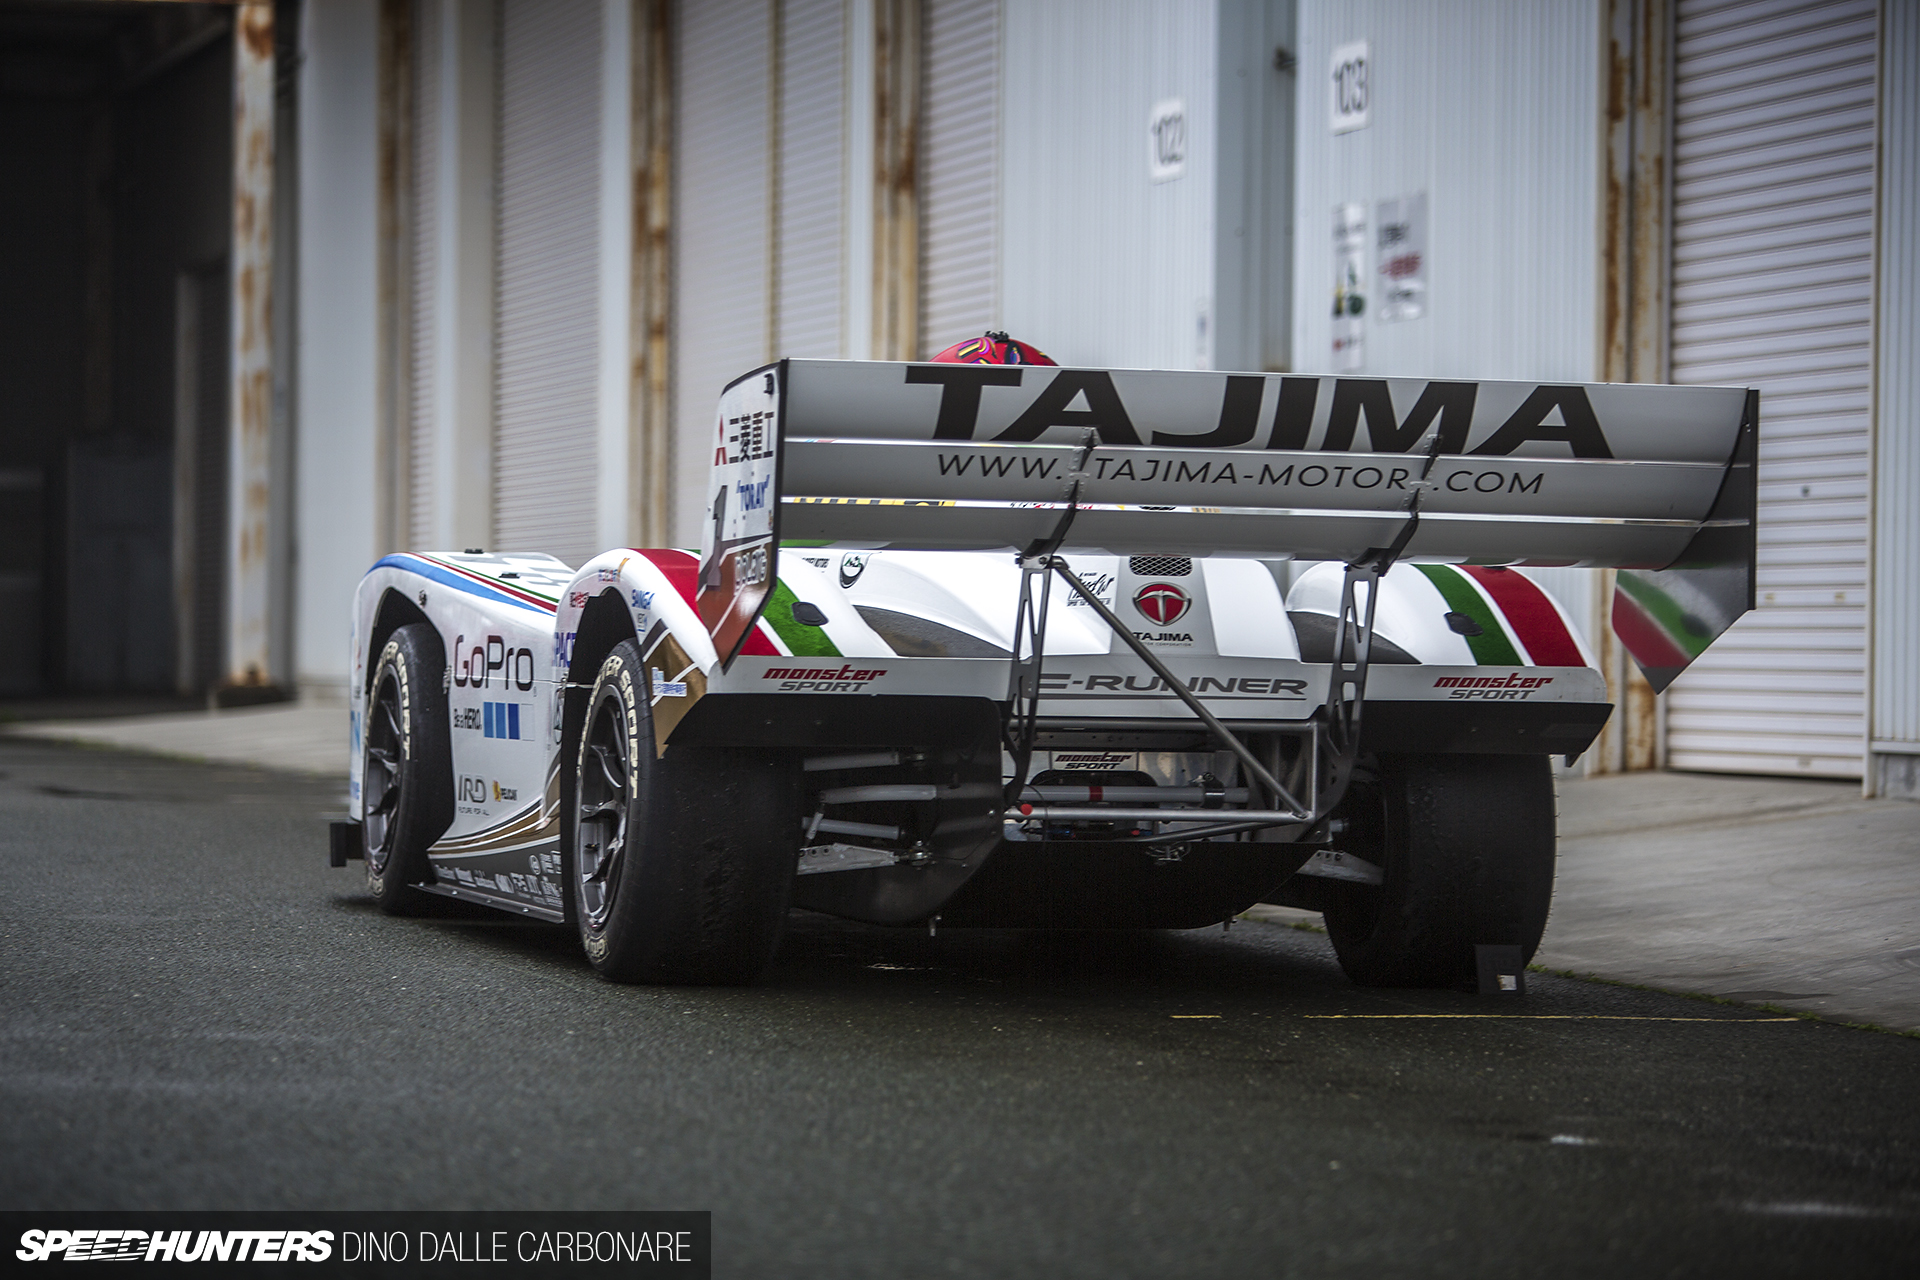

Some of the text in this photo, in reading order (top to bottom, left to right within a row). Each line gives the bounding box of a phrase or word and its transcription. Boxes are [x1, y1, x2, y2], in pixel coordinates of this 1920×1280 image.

[1331, 58, 1368, 116] 103
[904, 365, 1615, 459] TAJIMA
[728, 411, 774, 464] 三菱重工
[1132, 631, 1194, 642] TAJIMA
[454, 634, 535, 692] GoPro
[762, 663, 888, 681] monster
[1432, 672, 1555, 689] monster
[778, 681, 869, 692] SPORT
[1448, 689, 1536, 700] SPORT
[1064, 762, 1121, 770] SPORT
